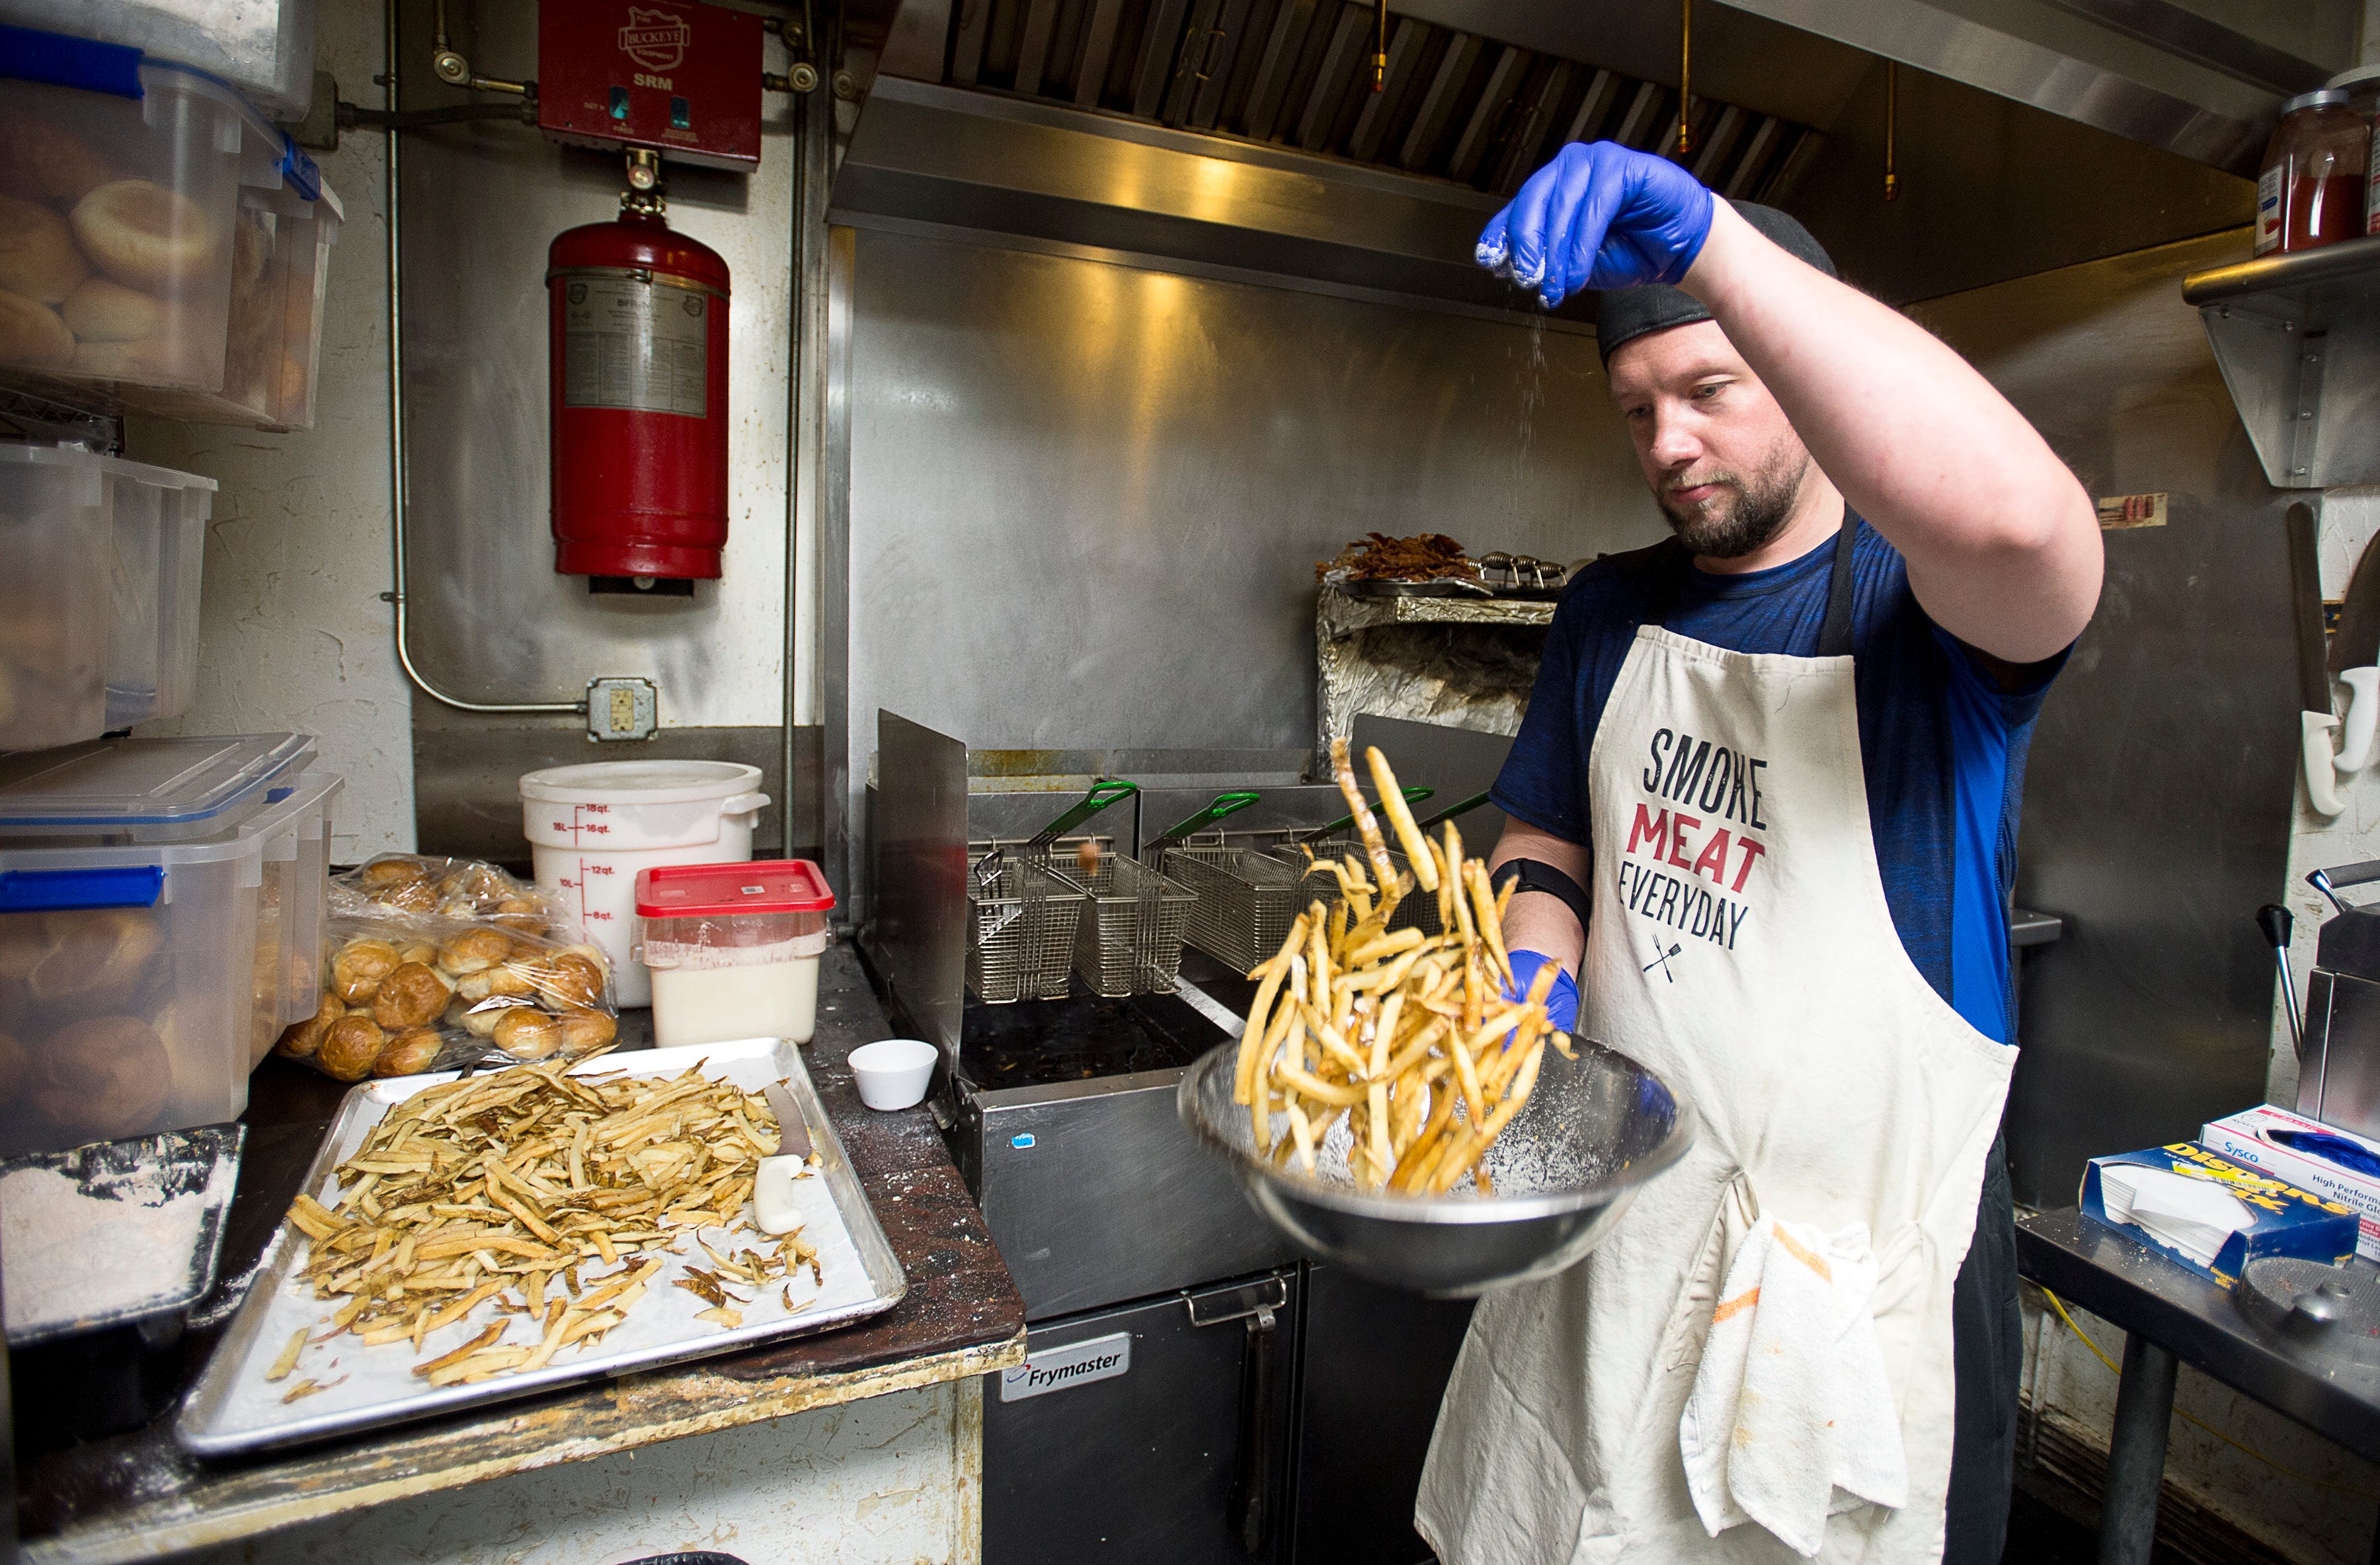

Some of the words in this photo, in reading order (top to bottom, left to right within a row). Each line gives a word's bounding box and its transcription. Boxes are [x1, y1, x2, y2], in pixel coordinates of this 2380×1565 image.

[628, 30, 680, 44] BUCKEYE
[633, 73, 673, 91] SRM
[1643, 728, 1768, 831] SMOKE
[1626, 803, 1766, 894] MEAT
[1620, 860, 1749, 950] EVERYDAY
[2224, 1142, 2259, 1163] Sysco
[2313, 1174, 2335, 1188] High
[2333, 1191, 2365, 1209] Nitrile
[1028, 1353, 1121, 1386] Frymaster
